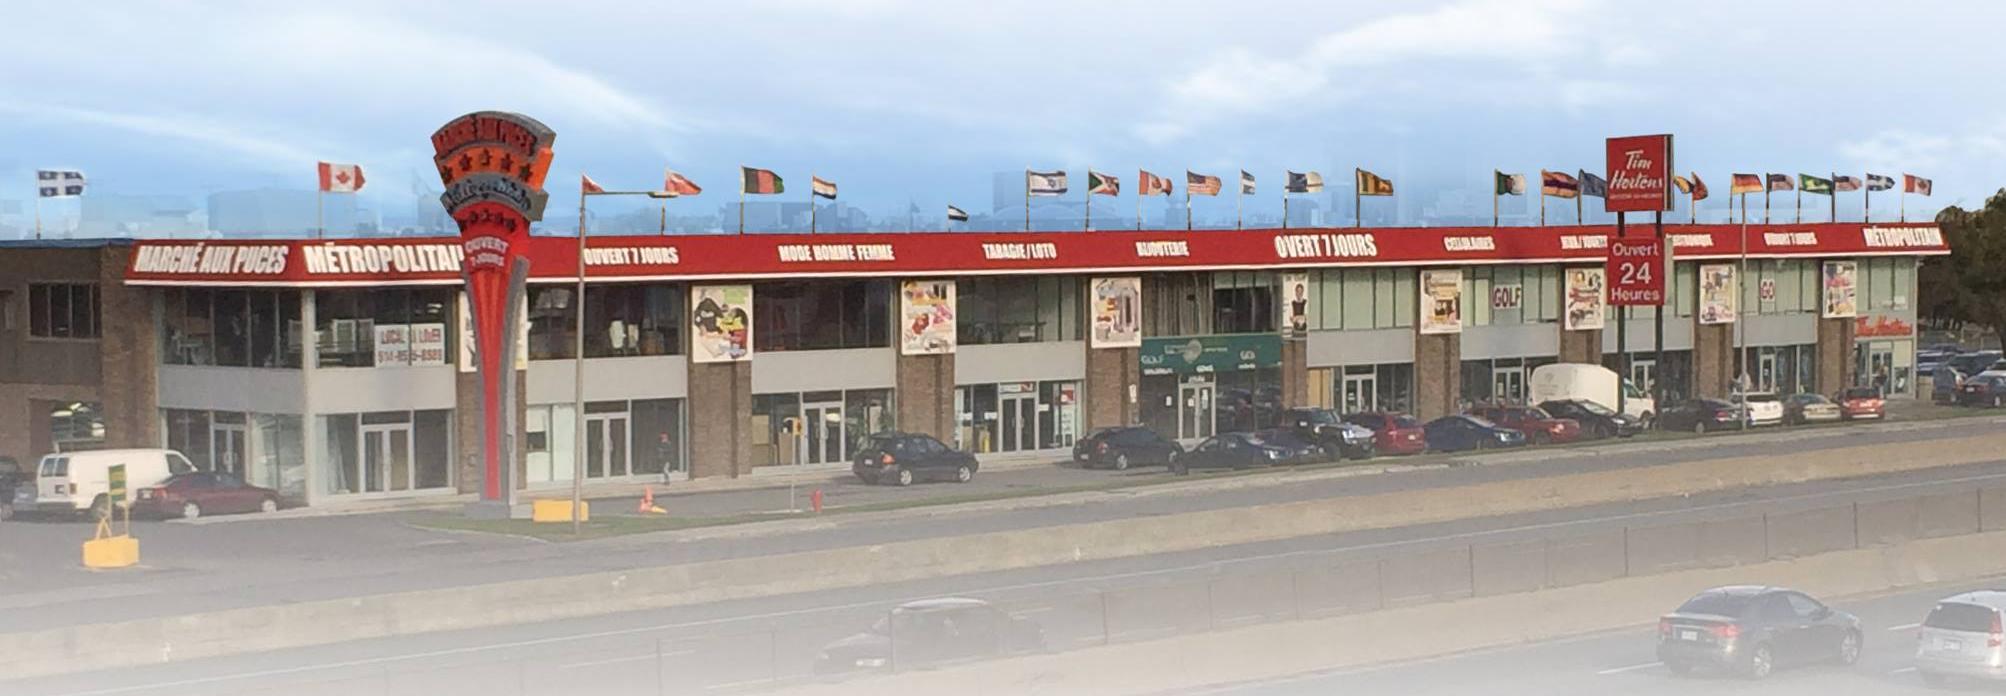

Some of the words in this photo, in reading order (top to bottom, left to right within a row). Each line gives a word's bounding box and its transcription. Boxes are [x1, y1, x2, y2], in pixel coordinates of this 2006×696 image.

[1625, 150, 1652, 170] Tim
[1610, 170, 1663, 189] Hortons
[778, 245, 812, 261] MODE
[812, 244, 856, 261] HOMME
[856, 244, 895, 260] FEMME
[1321, 234, 1331, 256] 7
[1331, 233, 1377, 256] JOURS
[1612, 242, 1658, 256] Ouvert
[134, 242, 204, 273] MARCHÉ
[200, 244, 236, 273] AUX
[234, 245, 288, 273] PUCES
[584, 247, 630, 265] OUVERT
[630, 247, 639, 264] 7
[640, 246, 679, 264] JOURS
[1620, 262, 1652, 284] 24
[1493, 287, 1521, 308] GOLF
[1611, 288, 1660, 301] Heures
